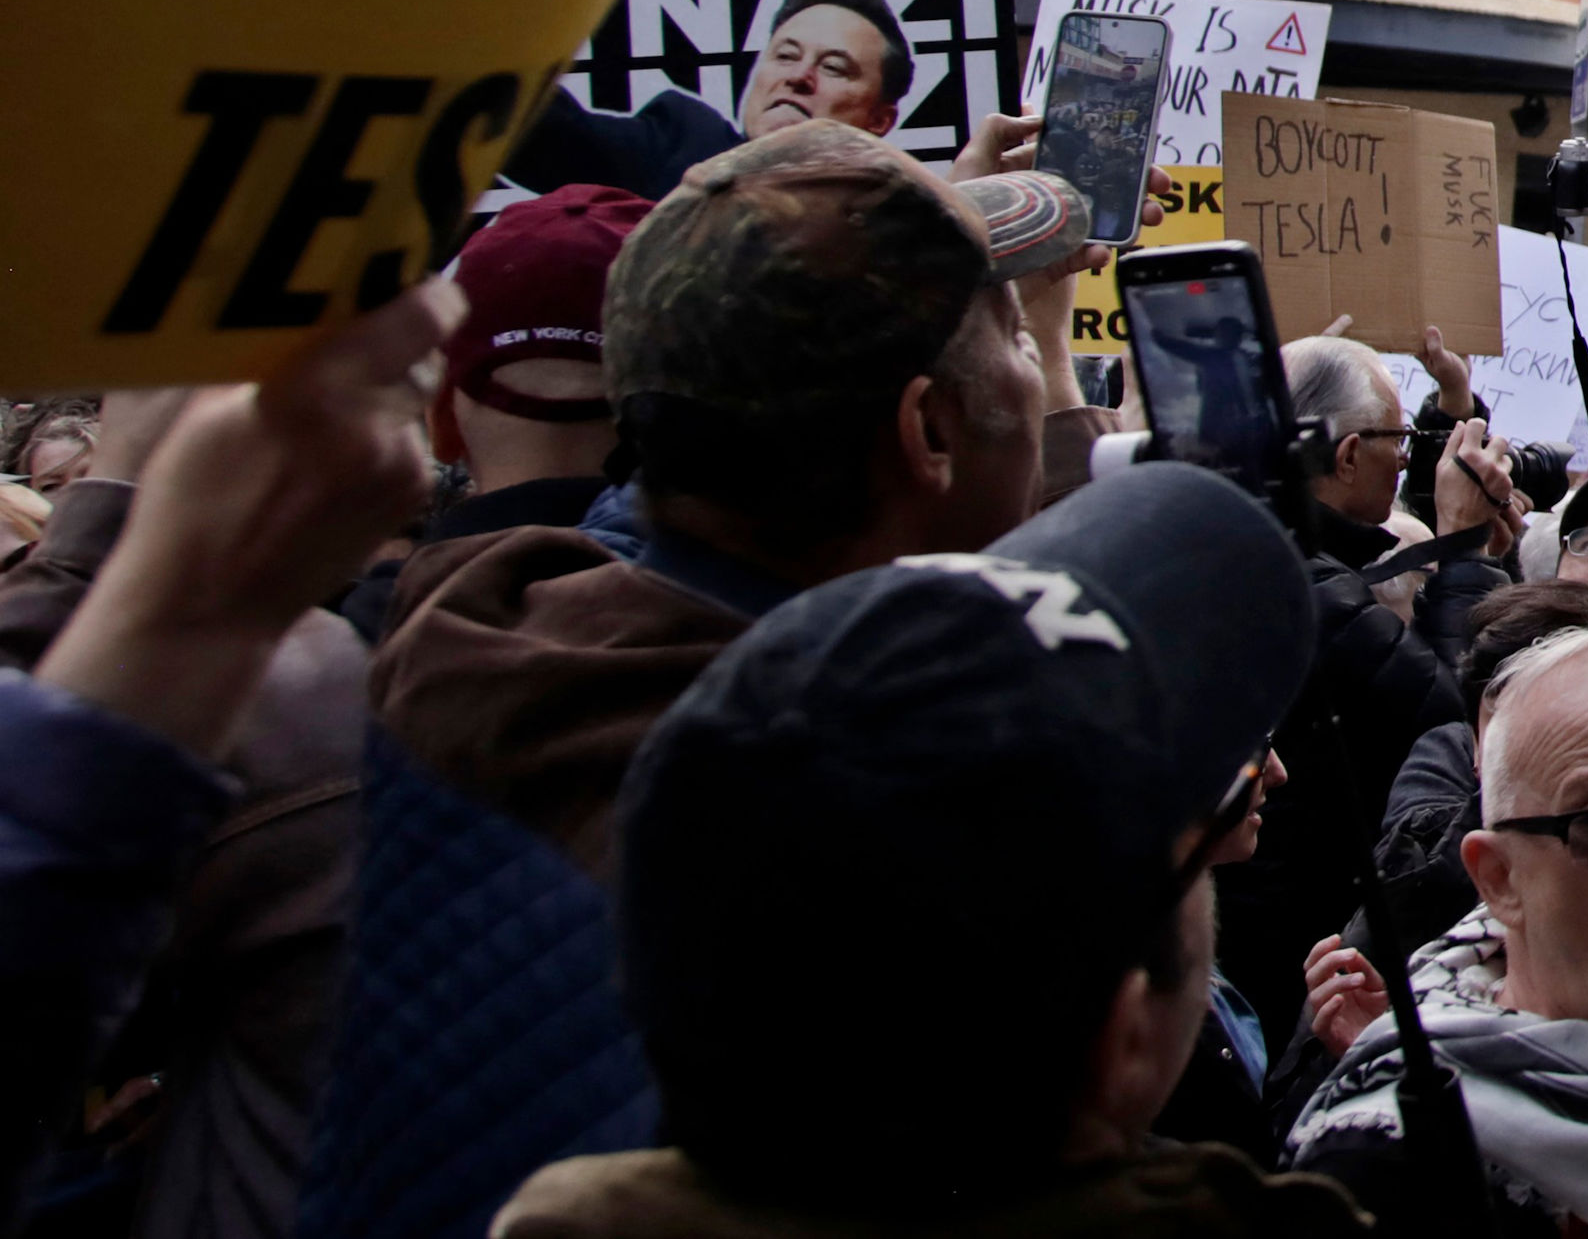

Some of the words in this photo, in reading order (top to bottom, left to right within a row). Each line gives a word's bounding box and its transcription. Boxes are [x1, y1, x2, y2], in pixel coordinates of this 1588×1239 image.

[1195, 6, 1238, 54] IS
[1255, 115, 1385, 178] BOYCOTT
[101, 69, 520, 335] TES
[1467, 153, 1493, 249] FUCK
[494, 330, 529, 347] NEW
[532, 326, 584, 340] YORK
[583, 330, 608, 347] CIT
